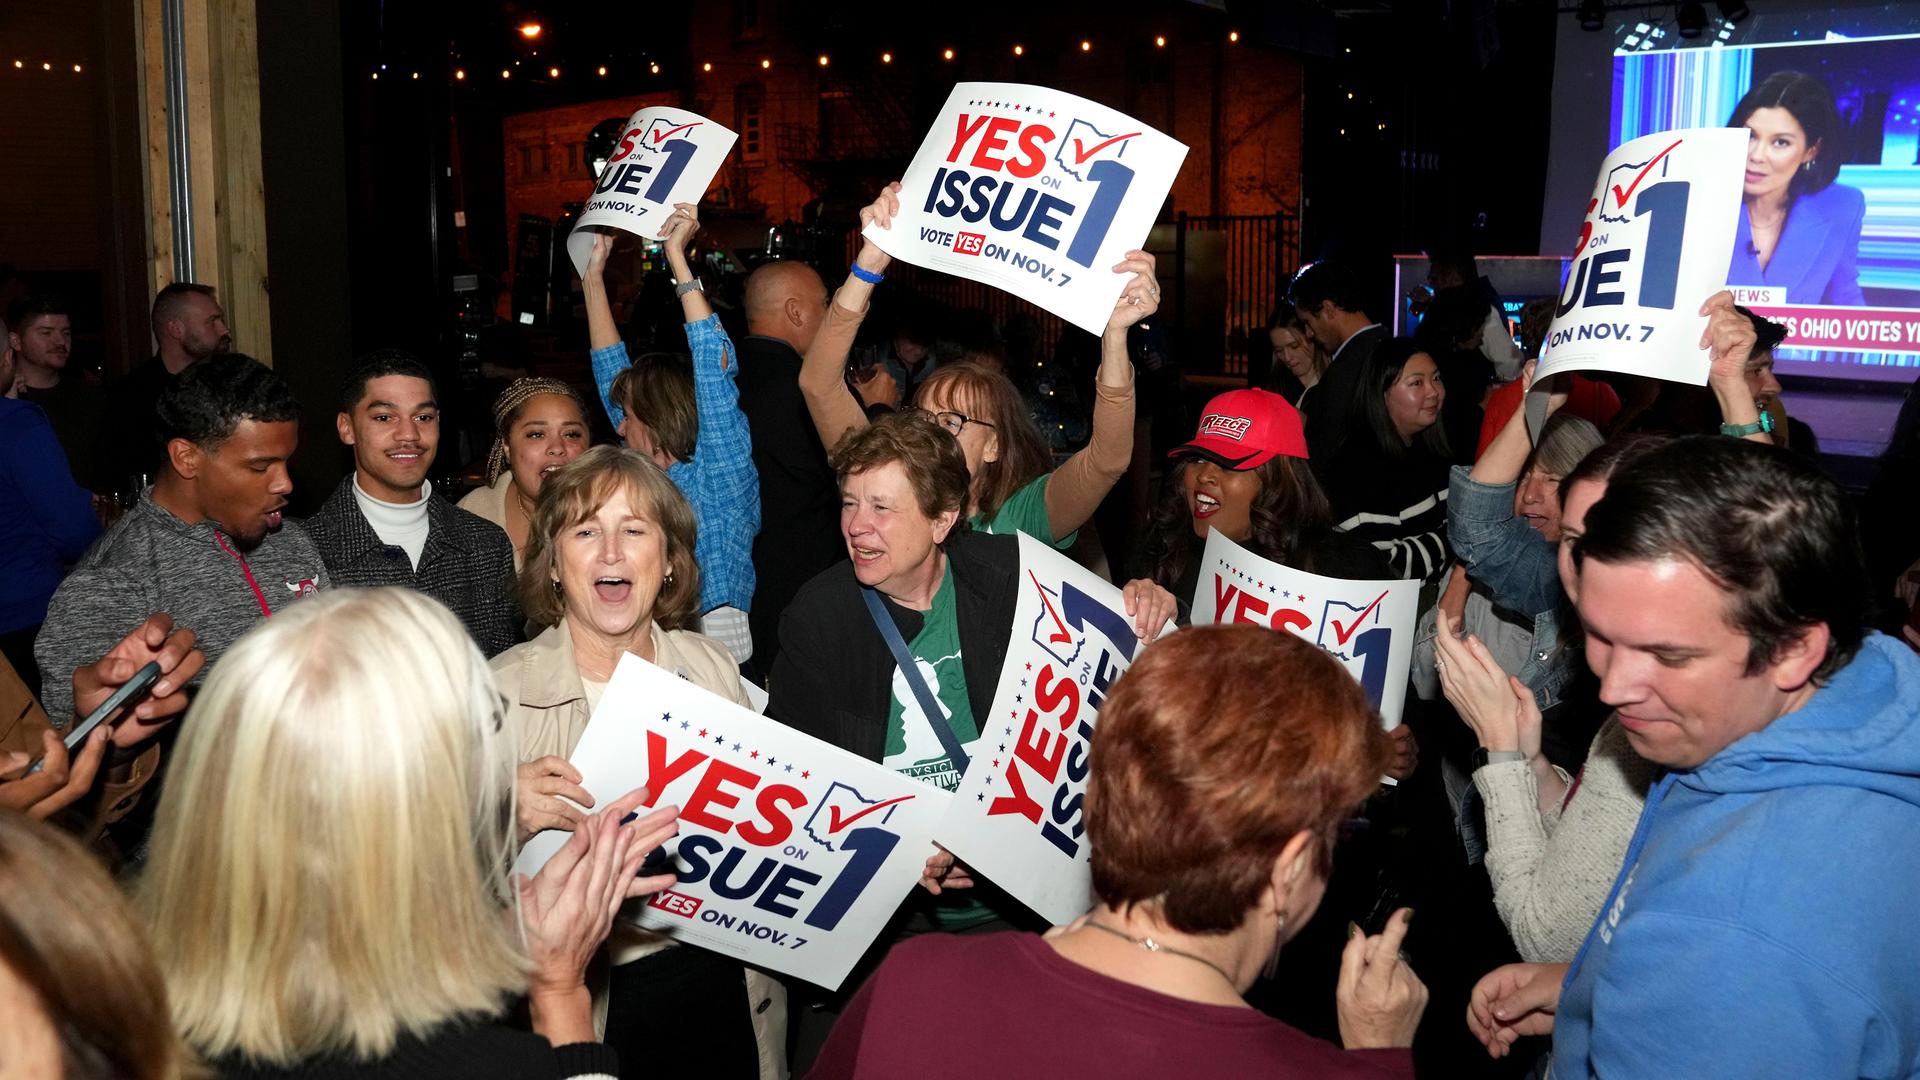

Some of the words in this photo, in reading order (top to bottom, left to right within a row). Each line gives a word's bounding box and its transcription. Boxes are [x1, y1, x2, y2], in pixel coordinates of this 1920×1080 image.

[629, 153, 644, 161] ON
[644, 139, 698, 204] 1
[946, 113, 1056, 178] YES
[589, 201, 605, 211] ON
[605, 201, 635, 214] NOV.
[637, 207, 648, 217] 7
[923, 167, 1076, 251] ISSUE
[1040, 175, 1062, 190] ON
[1066, 160, 1135, 268] 1
[919, 226, 954, 248] VOTE
[956, 232, 983, 254] YES
[984, 243, 1010, 263] ON
[1010, 252, 1056, 283] NOV.
[1057, 273, 1072, 287] 7
[1590, 233, 1609, 248] ON
[1634, 181, 1690, 310] 1
[1551, 327, 1573, 348] ON
[1577, 322, 1632, 341] NOV.
[1639, 325, 1655, 343] 7
[1800, 317, 1842, 339] OHIO
[1845, 319, 1902, 342] VOTES
[1201, 415, 1249, 431] REECE
[1062, 581, 1138, 663] 1
[1079, 661, 1092, 686] ON
[1353, 628, 1392, 716] 1
[987, 664, 1080, 825] YES
[1041, 648, 1124, 860] ISSE
[643, 729, 809, 846] YES
[783, 845, 809, 861] ON
[803, 827, 901, 931] 1
[656, 891, 697, 914] YES
[701, 909, 737, 928] ON
[737, 920, 786, 947] NOV.
[790, 939, 808, 950] 7
